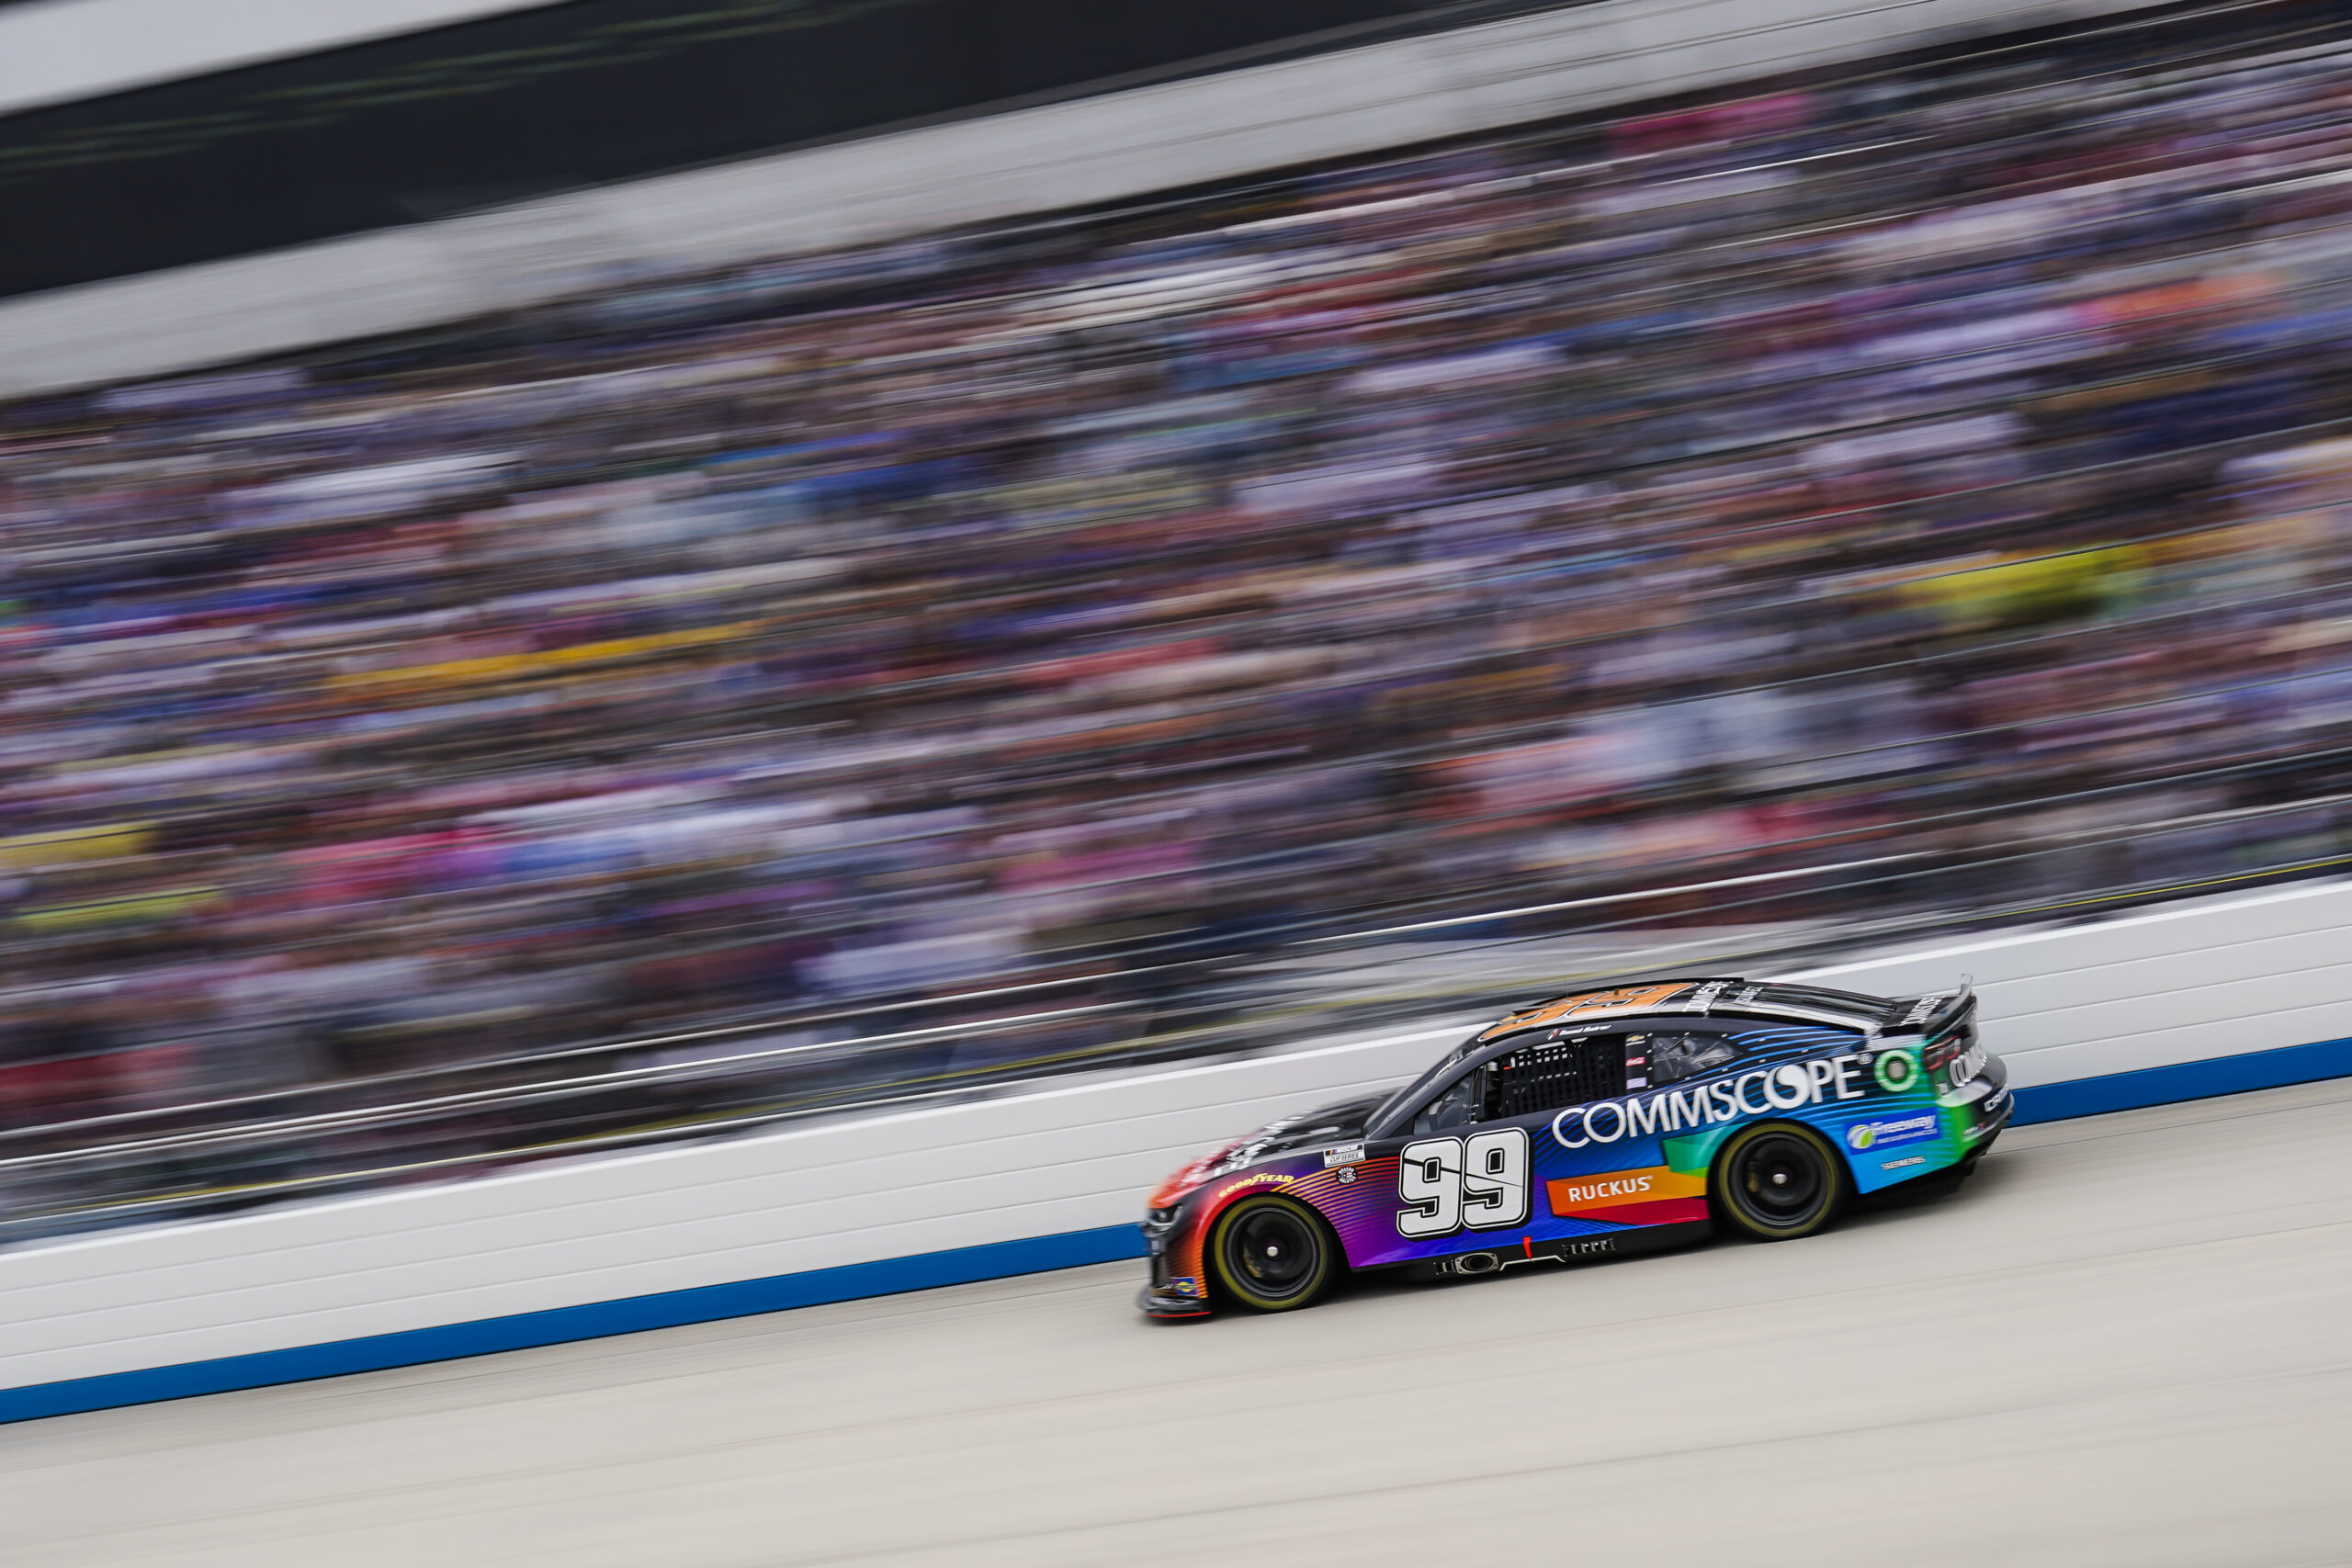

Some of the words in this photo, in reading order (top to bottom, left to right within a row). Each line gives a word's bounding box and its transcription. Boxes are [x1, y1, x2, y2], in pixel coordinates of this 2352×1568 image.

[1551, 1054, 1866, 1149] COMMSCOPE
[1871, 1115, 1936, 1135] Freeway
[1341, 1152, 1359, 1160] SERIES
[1218, 1172, 1295, 1198] GOODYEAR
[1396, 1127, 1534, 1242] 99
[1567, 1176, 1651, 1202] RUCKUS
